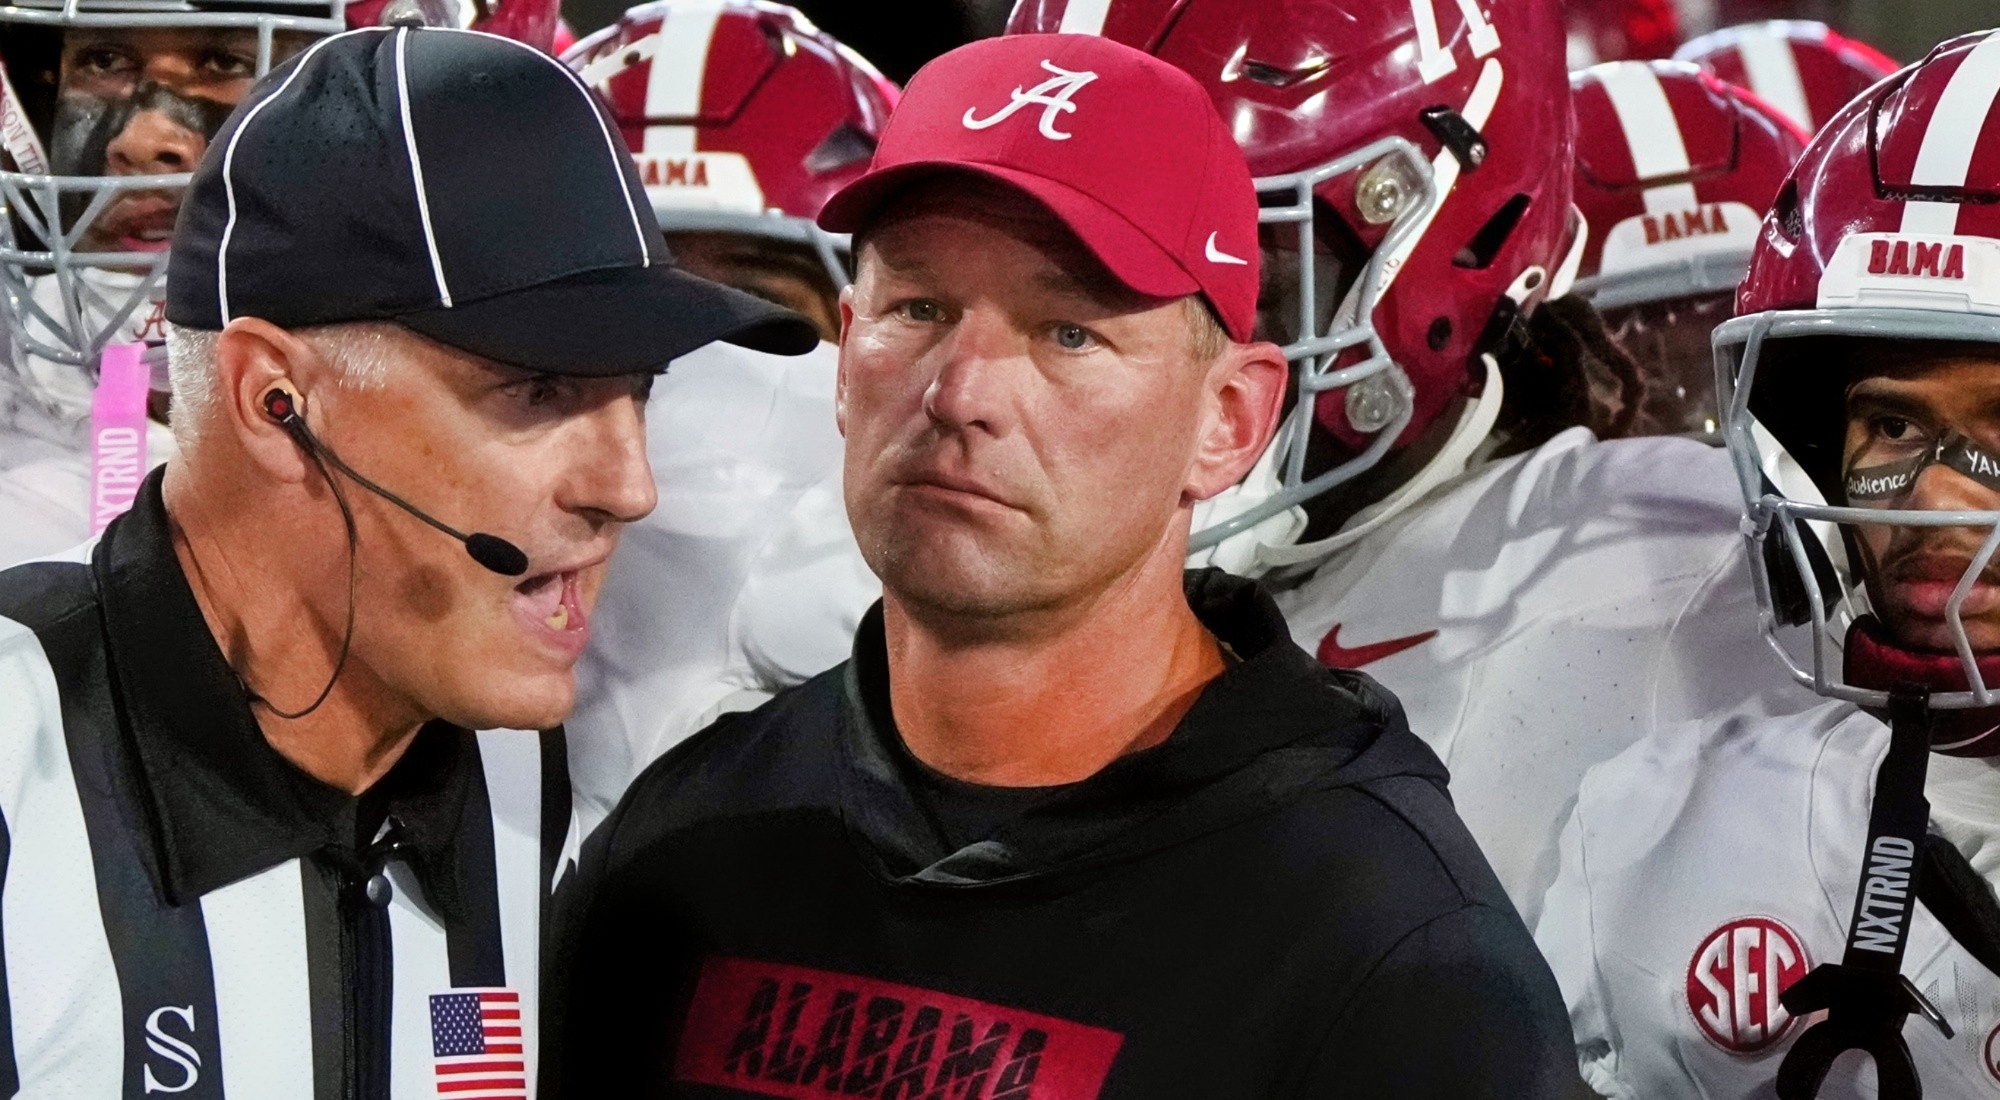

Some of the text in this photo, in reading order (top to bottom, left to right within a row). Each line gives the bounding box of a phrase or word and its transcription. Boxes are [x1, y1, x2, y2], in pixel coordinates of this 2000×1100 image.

[962, 59, 1099, 140] A
[634, 158, 708, 186] AMA
[1642, 204, 1729, 246] BAMA
[1867, 239, 1965, 279] BAMA
[1847, 472, 1908, 496] Audience
[1852, 835, 1915, 954] NXTRND
[1694, 926, 1797, 1043] SEC
[143, 1004, 202, 1094] S
[722, 976, 1049, 1100] ALABAMA
